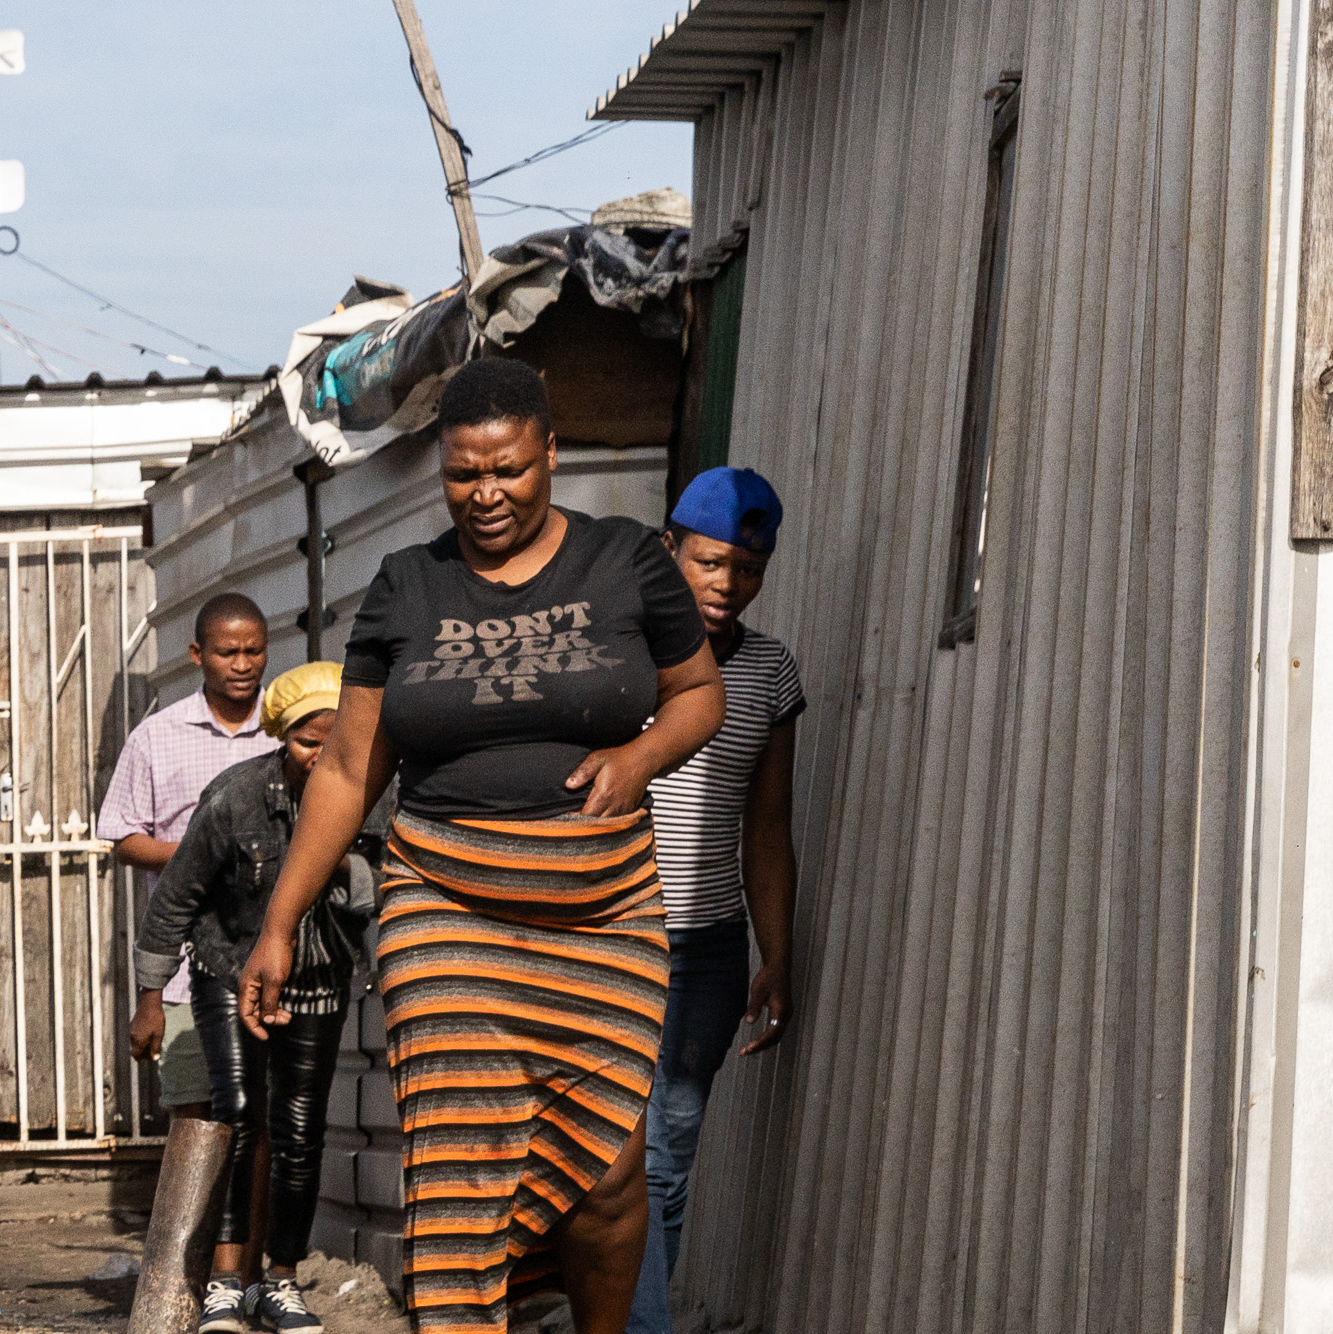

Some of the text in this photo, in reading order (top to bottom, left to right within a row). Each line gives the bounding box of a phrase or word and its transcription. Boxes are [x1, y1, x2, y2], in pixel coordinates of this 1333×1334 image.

[434, 602, 592, 641] DON'T
[433, 631, 595, 660] OVER
[402, 645, 626, 685] THINK
[472, 675, 544, 705] IT
